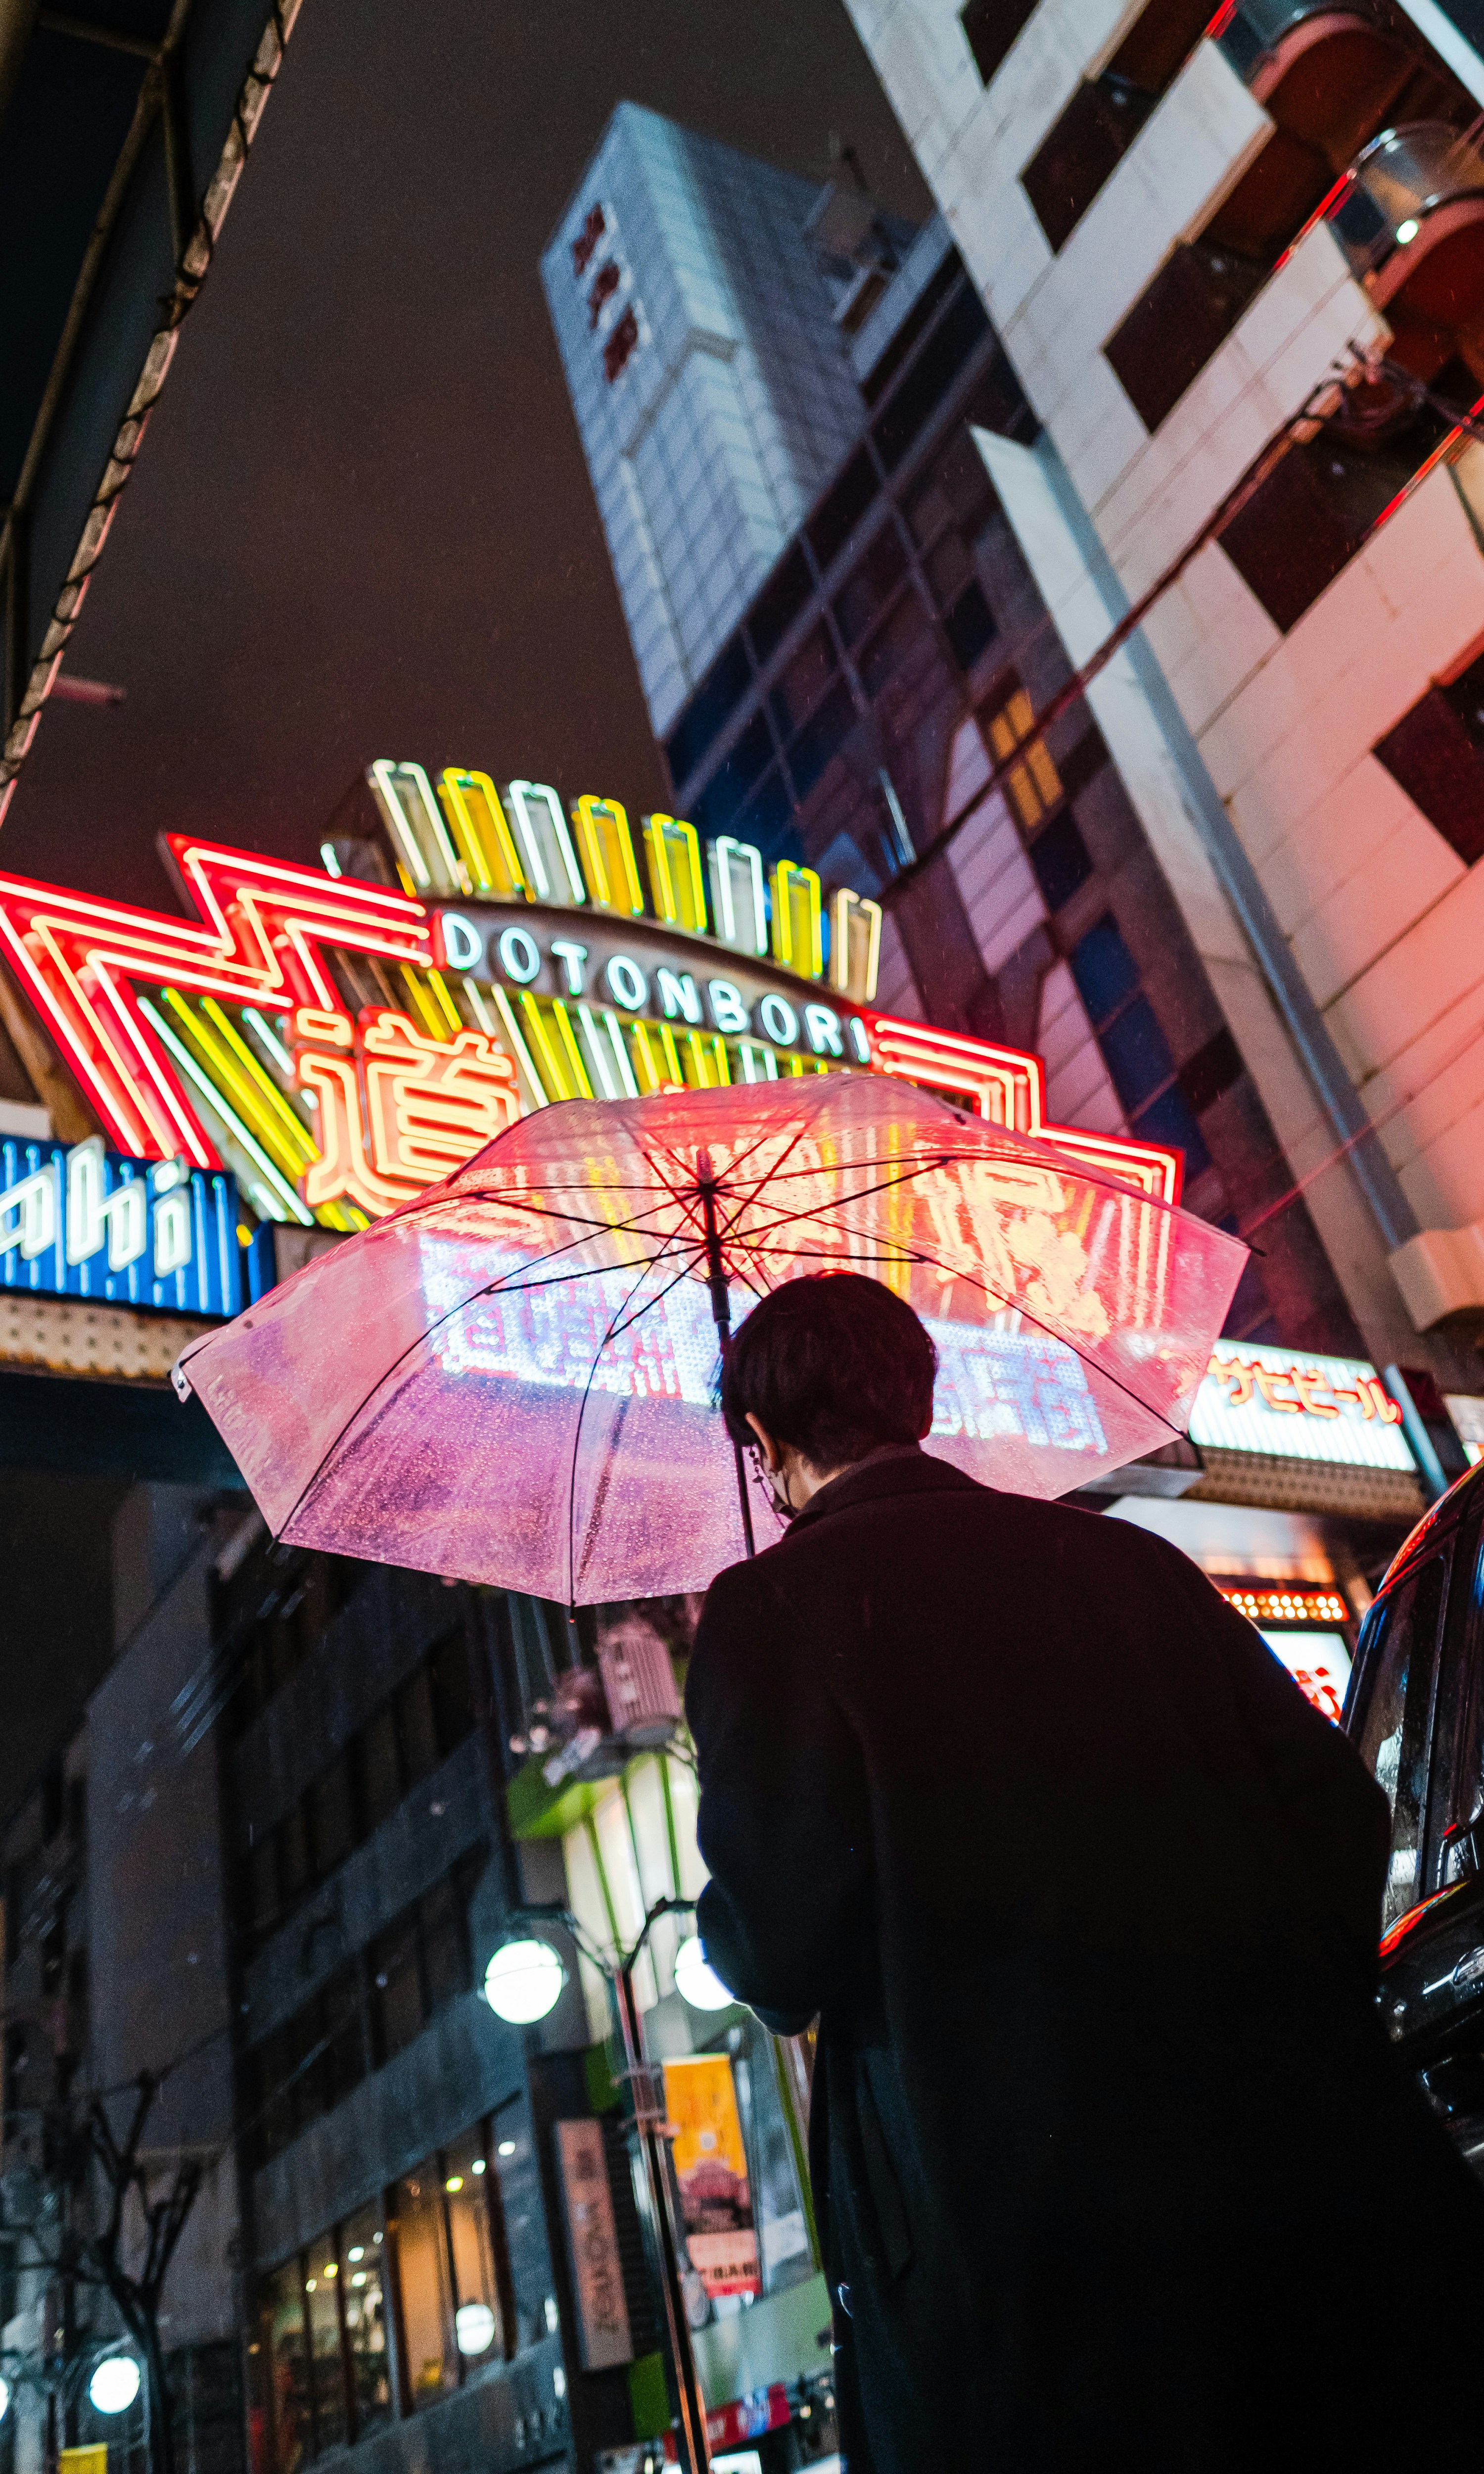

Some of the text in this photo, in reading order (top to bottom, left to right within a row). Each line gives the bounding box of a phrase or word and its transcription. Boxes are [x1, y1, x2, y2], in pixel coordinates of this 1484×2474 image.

[441, 911, 872, 1063] DOTONBORI
[1177, 1351, 1403, 1425] サヒビール
